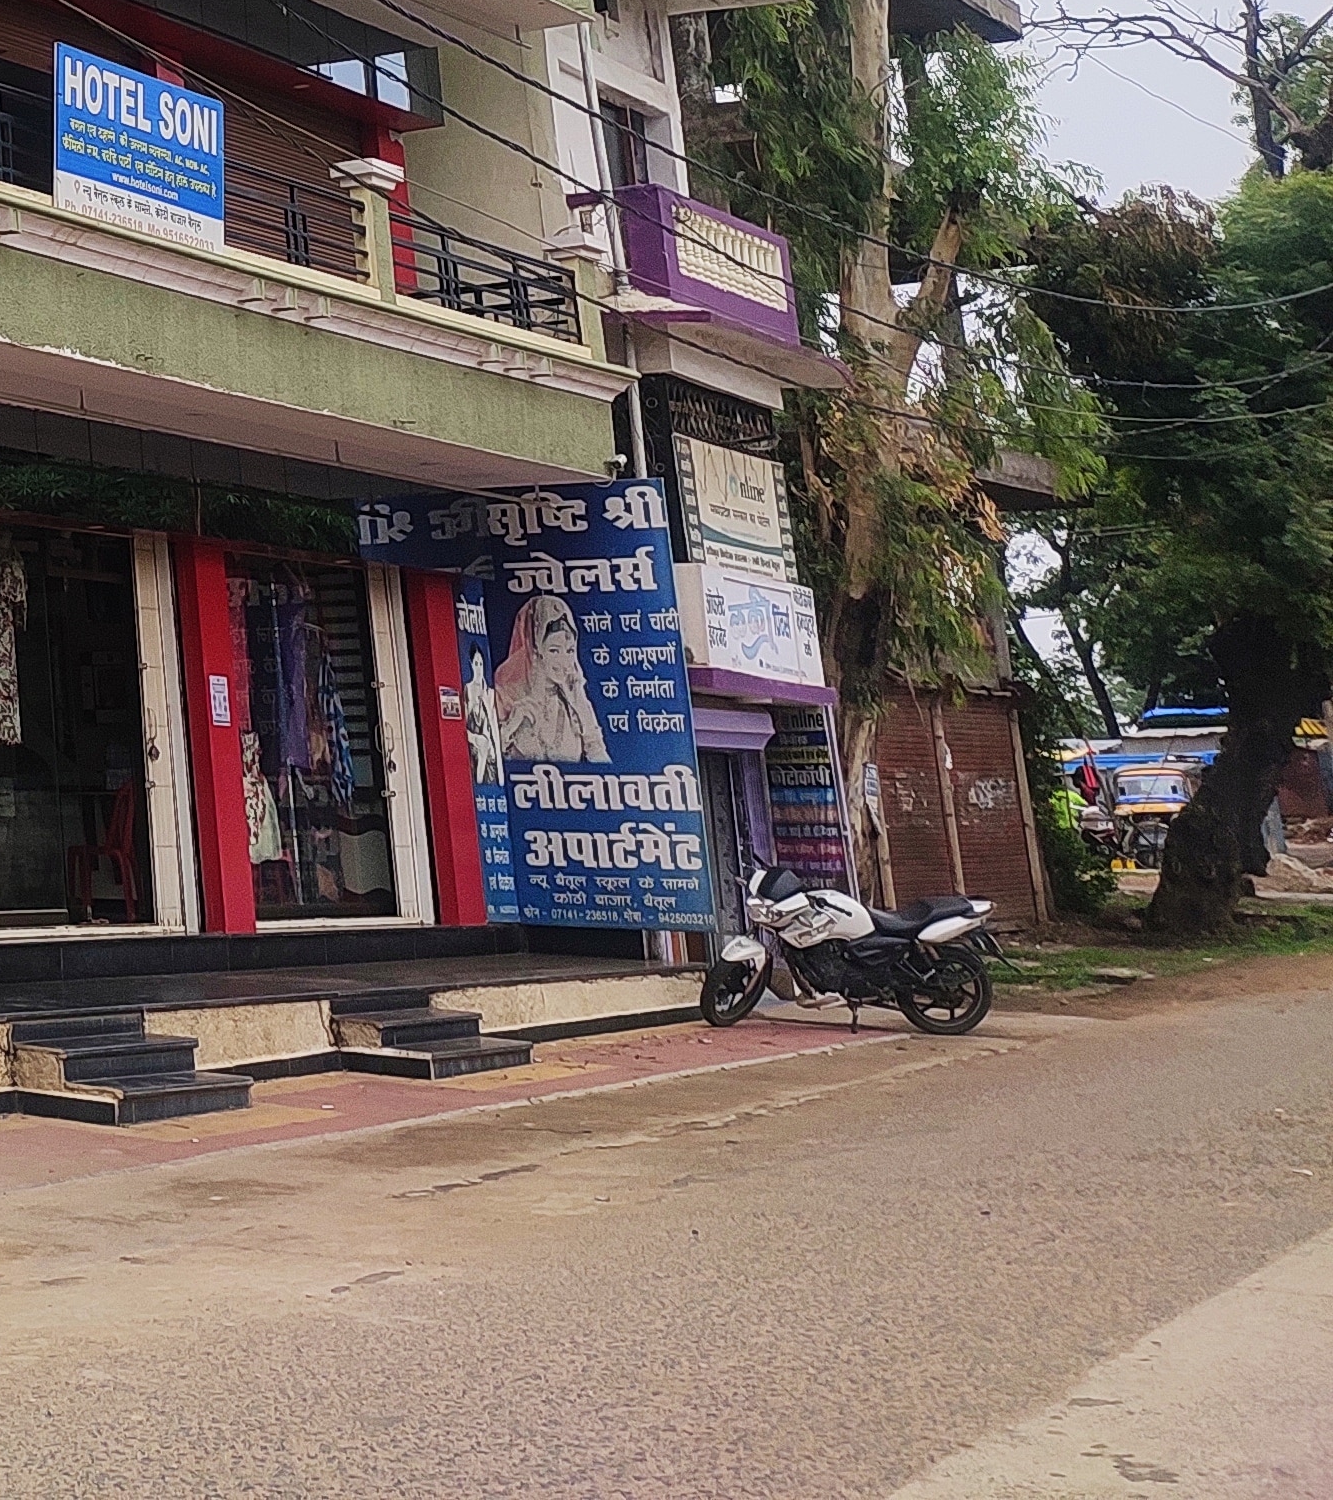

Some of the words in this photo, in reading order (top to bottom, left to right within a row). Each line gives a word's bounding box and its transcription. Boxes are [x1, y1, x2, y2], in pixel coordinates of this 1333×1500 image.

[64, 56, 152, 133] HOTEL
[158, 91, 218, 156] SONI
[487, 491, 589, 546] सृष्टि
[602, 485, 668, 530] श्री
[503, 545, 658, 593] ज्वेलर्स
[580, 610, 612, 633] सोने
[619, 608, 641, 632] एवं
[648, 607, 679, 631] चांदी
[591, 643, 610, 666] के
[619, 641, 676, 670] आभूषणों
[600, 677, 619, 698] के
[626, 675, 675, 698] निर्माता
[607, 709, 629, 732] एवं
[636, 708, 685, 734] विक्रेता
[509, 764, 703, 811] लीलावती
[524, 822, 703, 870] अपार्टमेंट
[528, 874, 550, 890] न्यू
[554, 871, 587, 891] बैतूल
[594, 875, 631, 892] स्कूल
[637, 875, 655, 890] के
[553, 891, 587, 906] कोठी
[643, 891, 677, 910] बैतूल
